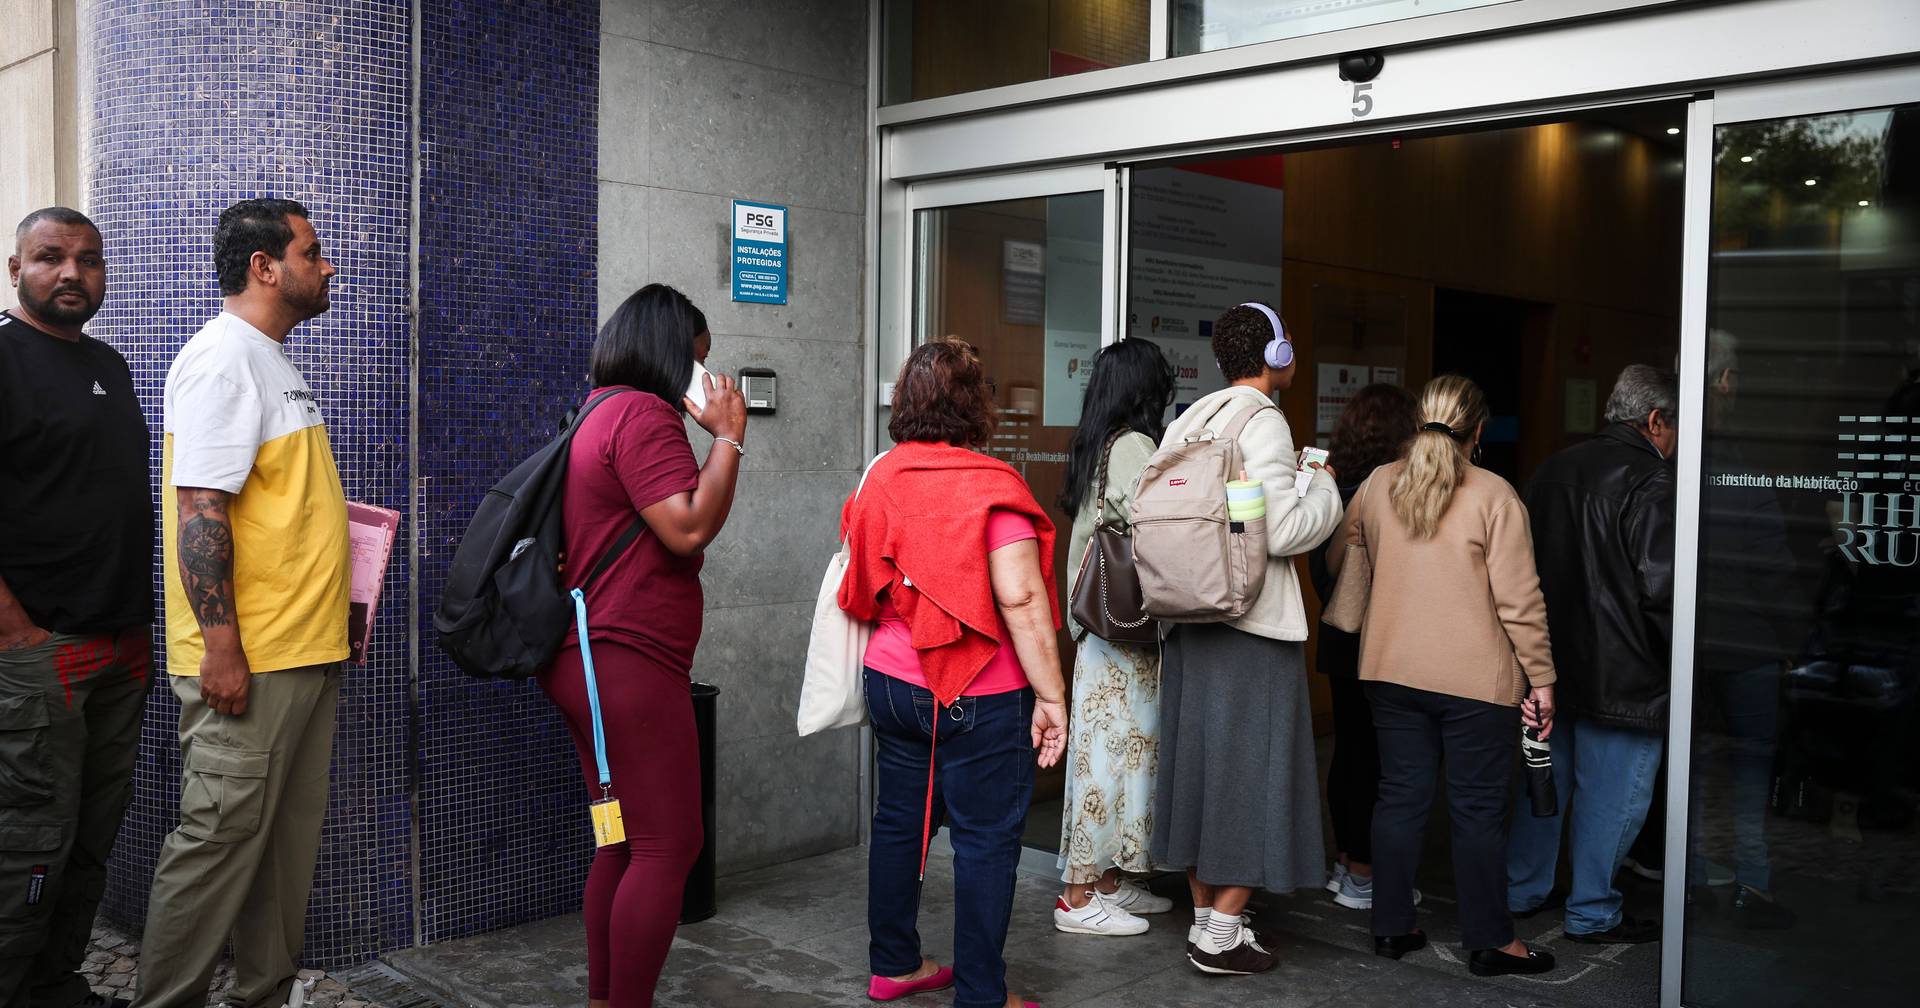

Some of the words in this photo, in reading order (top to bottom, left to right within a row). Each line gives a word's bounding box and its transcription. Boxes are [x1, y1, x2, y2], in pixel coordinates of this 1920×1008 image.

[1352, 83, 1373, 117] 5
[746, 213, 773, 227] PSG
[737, 246, 782, 258] INSTALAÇÕES
[737, 257, 782, 268] PROTEGIDAS
[1721, 473, 1773, 488] Instituto
